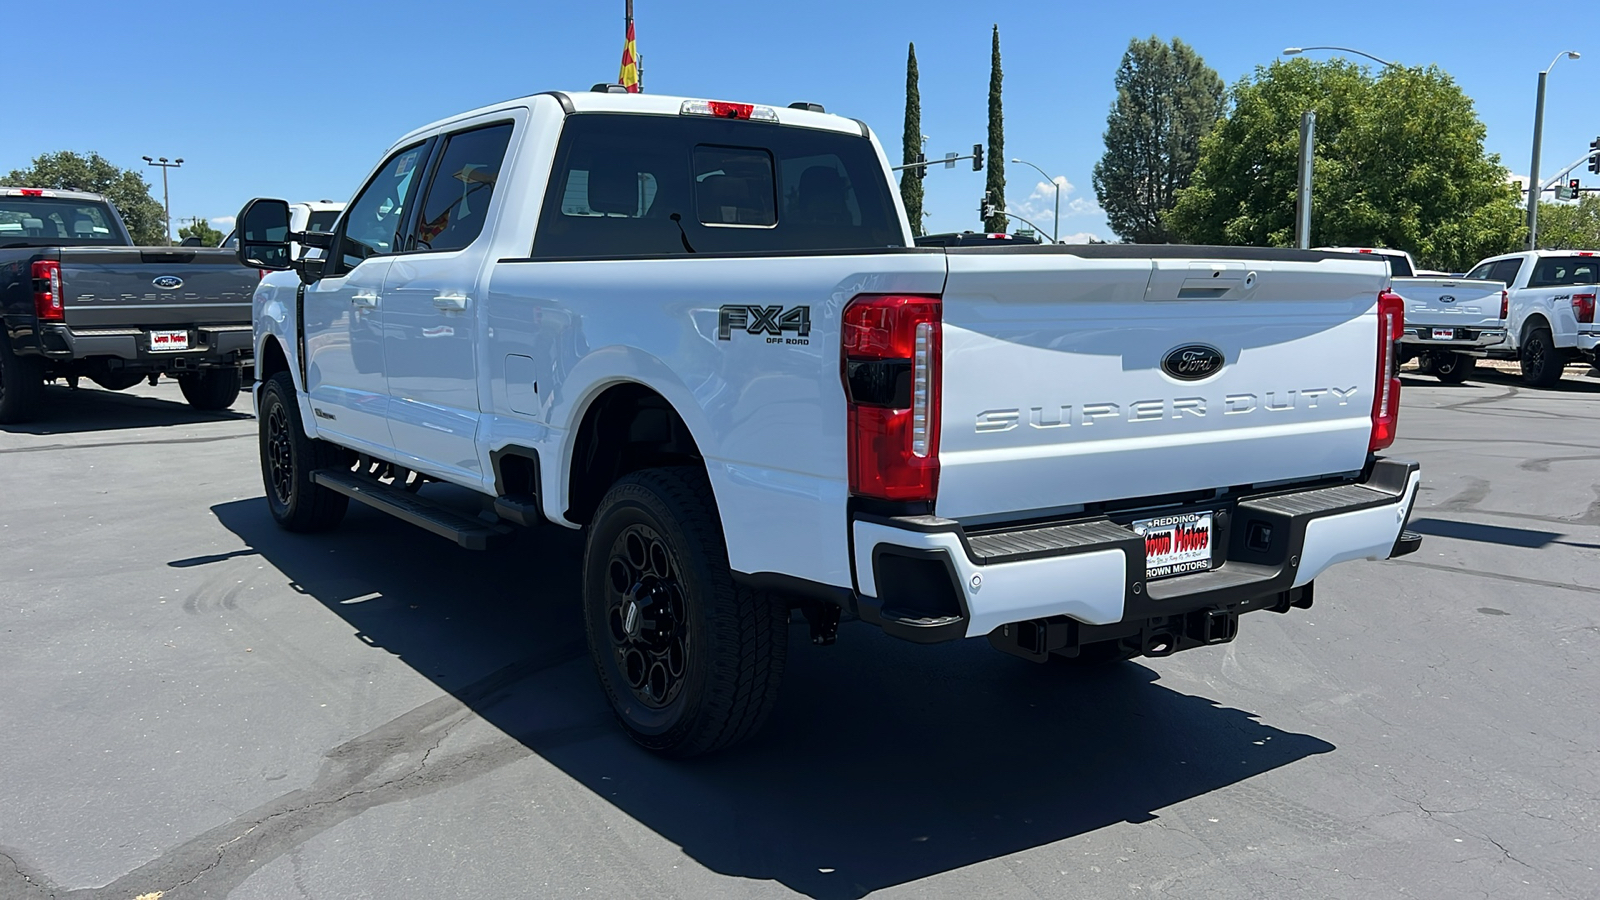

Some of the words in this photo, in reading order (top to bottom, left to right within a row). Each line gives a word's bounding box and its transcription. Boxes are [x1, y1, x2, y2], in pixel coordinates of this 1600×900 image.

[718, 304, 811, 341] FX4
[785, 338, 810, 346] ROAD
[1178, 350, 1213, 373] Ford
[974, 396, 1207, 434] SUPER
[1224, 385, 1358, 415] DUTY
[1153, 514, 1195, 528] REDDING
[1144, 529, 1171, 557] rown
[1174, 523, 1208, 553] Motors
[1146, 566, 1171, 578] ROWN
[1172, 560, 1208, 573] MOTORS
